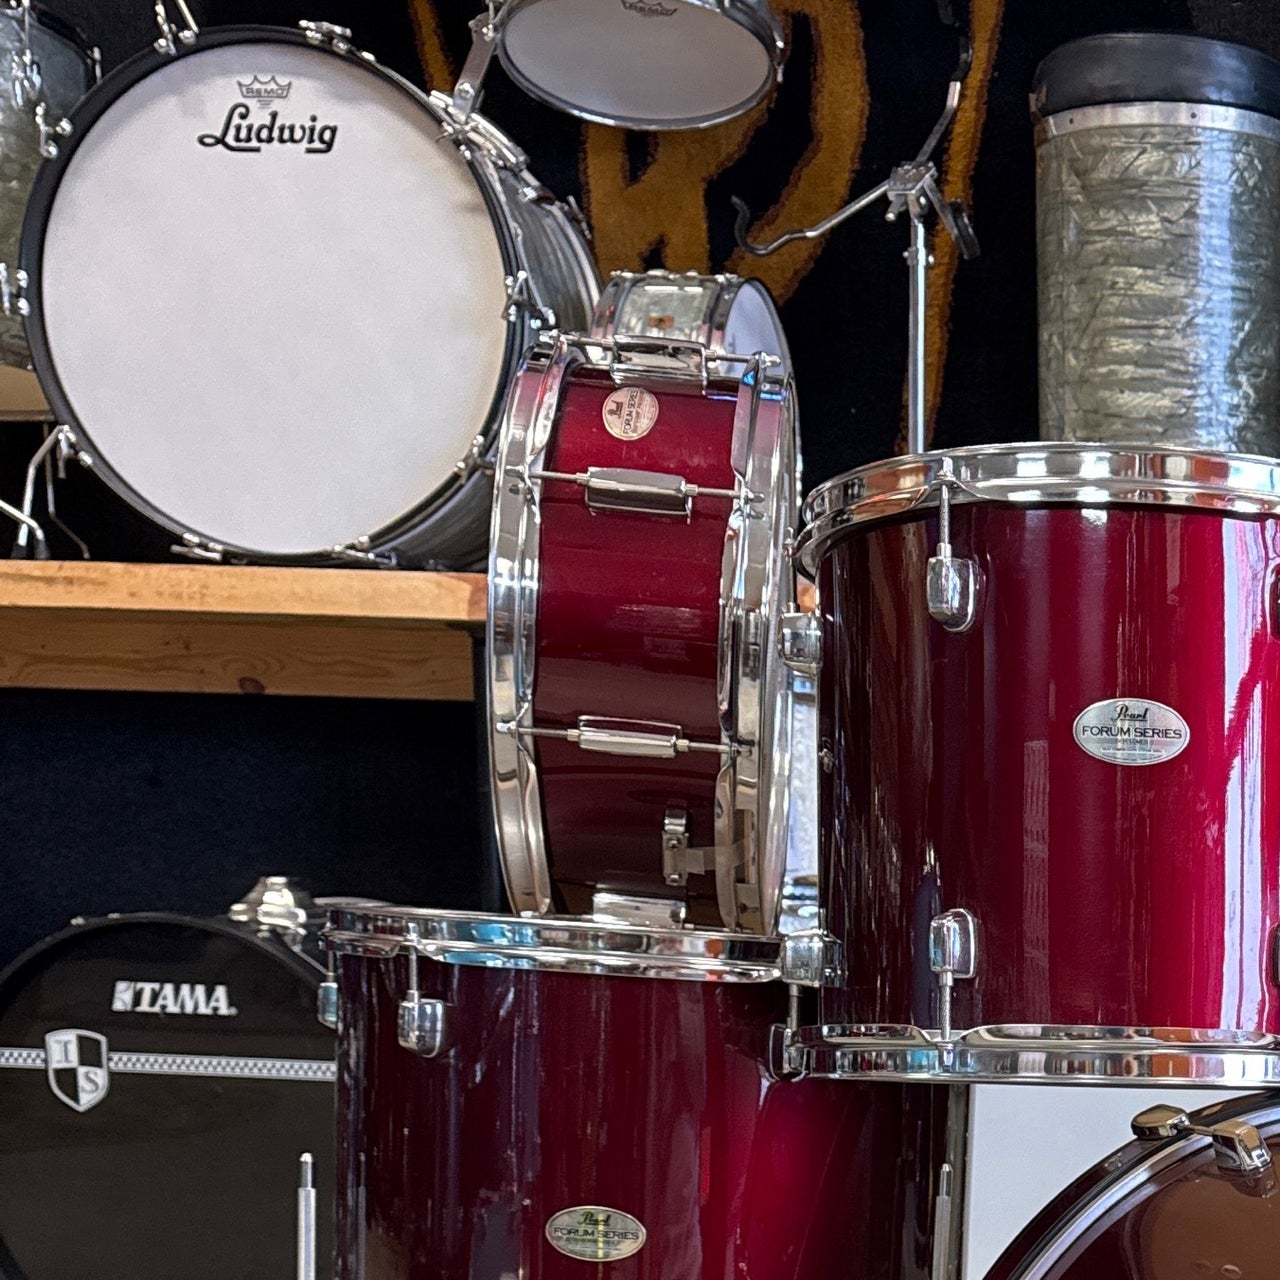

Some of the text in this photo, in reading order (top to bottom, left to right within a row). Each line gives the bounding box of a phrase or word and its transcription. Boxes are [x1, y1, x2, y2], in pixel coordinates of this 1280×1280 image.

[245, 87, 287, 97] REMO
[197, 102, 337, 153] Ludwig
[1111, 704, 1149, 721] Pearl
[1082, 726, 1182, 739] FORUM SERIES
[134, 981, 230, 1016] TAMA
[80, 1070, 99, 1094] S
[554, 1226, 639, 1240] FORUM SERIES
